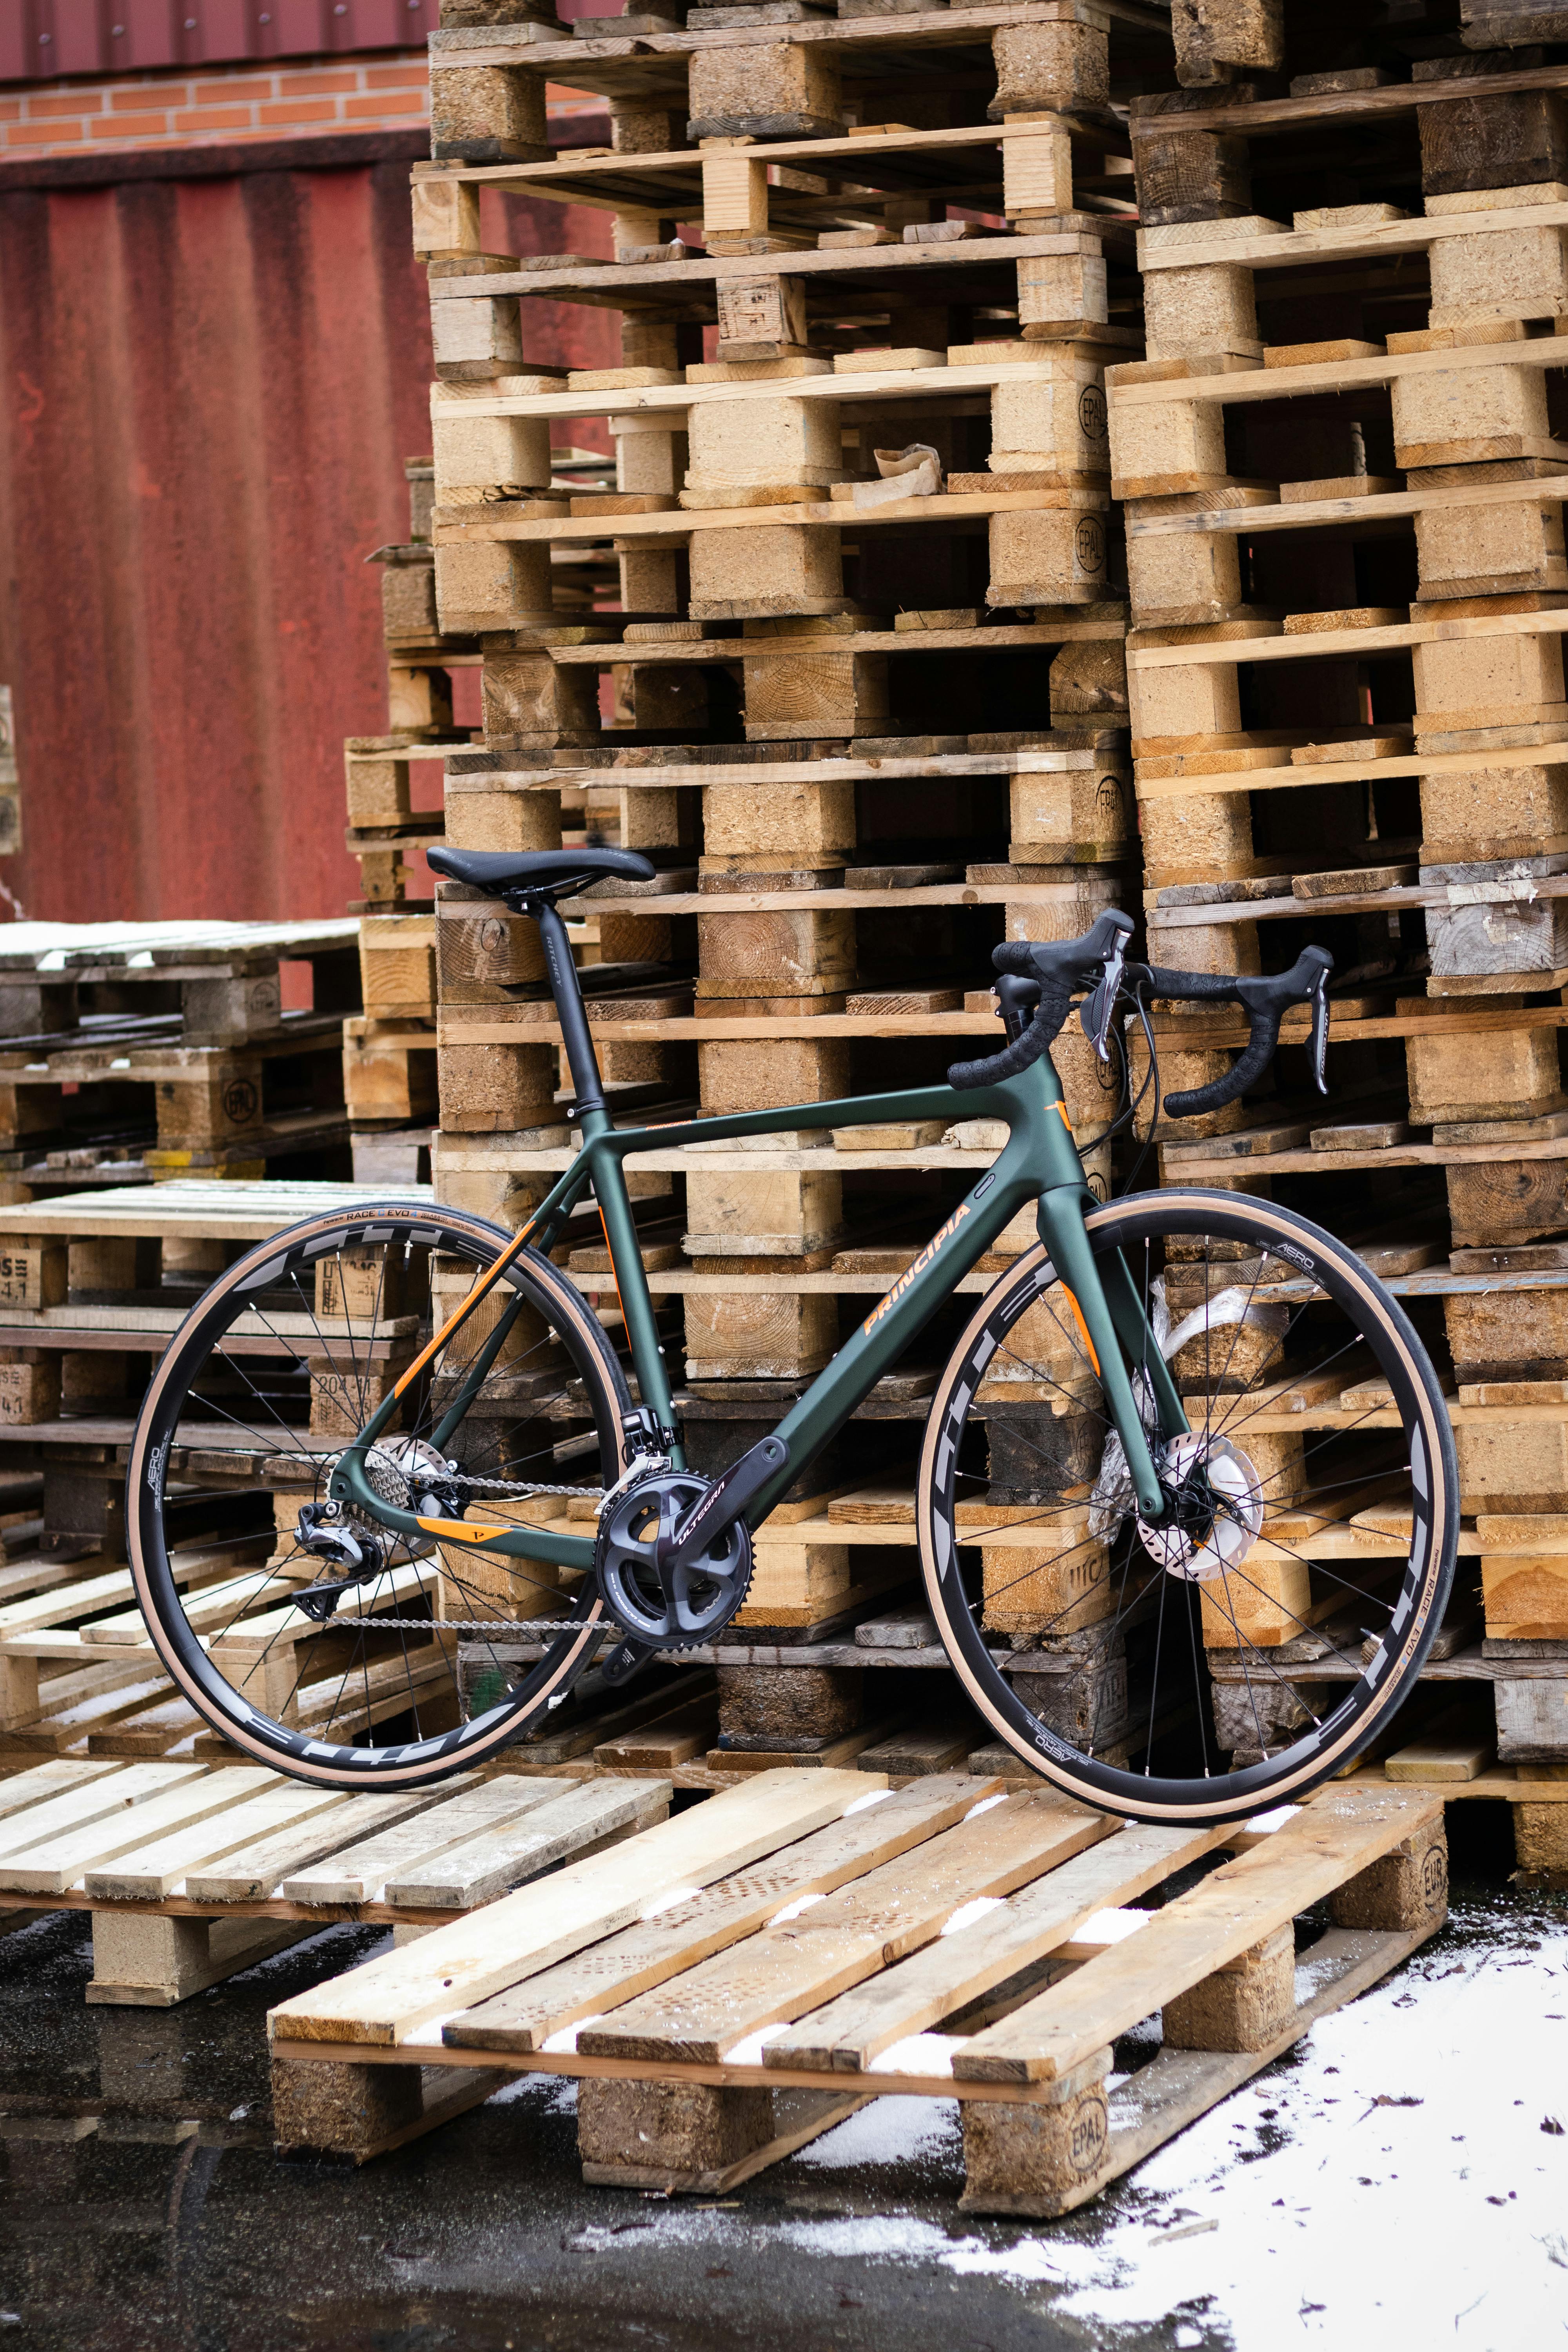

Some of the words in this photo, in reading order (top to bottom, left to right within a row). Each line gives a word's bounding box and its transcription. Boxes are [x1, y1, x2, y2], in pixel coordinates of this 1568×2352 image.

[1083, 398, 1105, 427] EPAL
[1079, 530, 1101, 559] EPAL
[546, 936, 563, 987] RITCHEY
[1321, 1012, 1329, 1075] ULTEGRA
[646, 1120, 692, 1131] PRINCIPIA
[323, 1216, 344, 1225] Panaracer
[347, 1210, 376, 1220] RACE
[864, 1204, 971, 1336] PRINCIPIA
[1277, 1243, 1314, 1269] AERO
[147, 1447, 160, 1491] AERO
[678, 1481, 724, 1545] ULTEGRA
[615, 1591, 638, 1620] ULTEGRA
[1421, 1580, 1435, 1615] RACE
[1406, 1628, 1420, 1657] EVO
[1401, 1655, 1408, 1665] 4
[1026, 1719, 1034, 1727] RIM
[1035, 1735, 1072, 1762] AERO
[1425, 1857, 1443, 1897] EUR
[1073, 2113, 1102, 2156] EPAL
